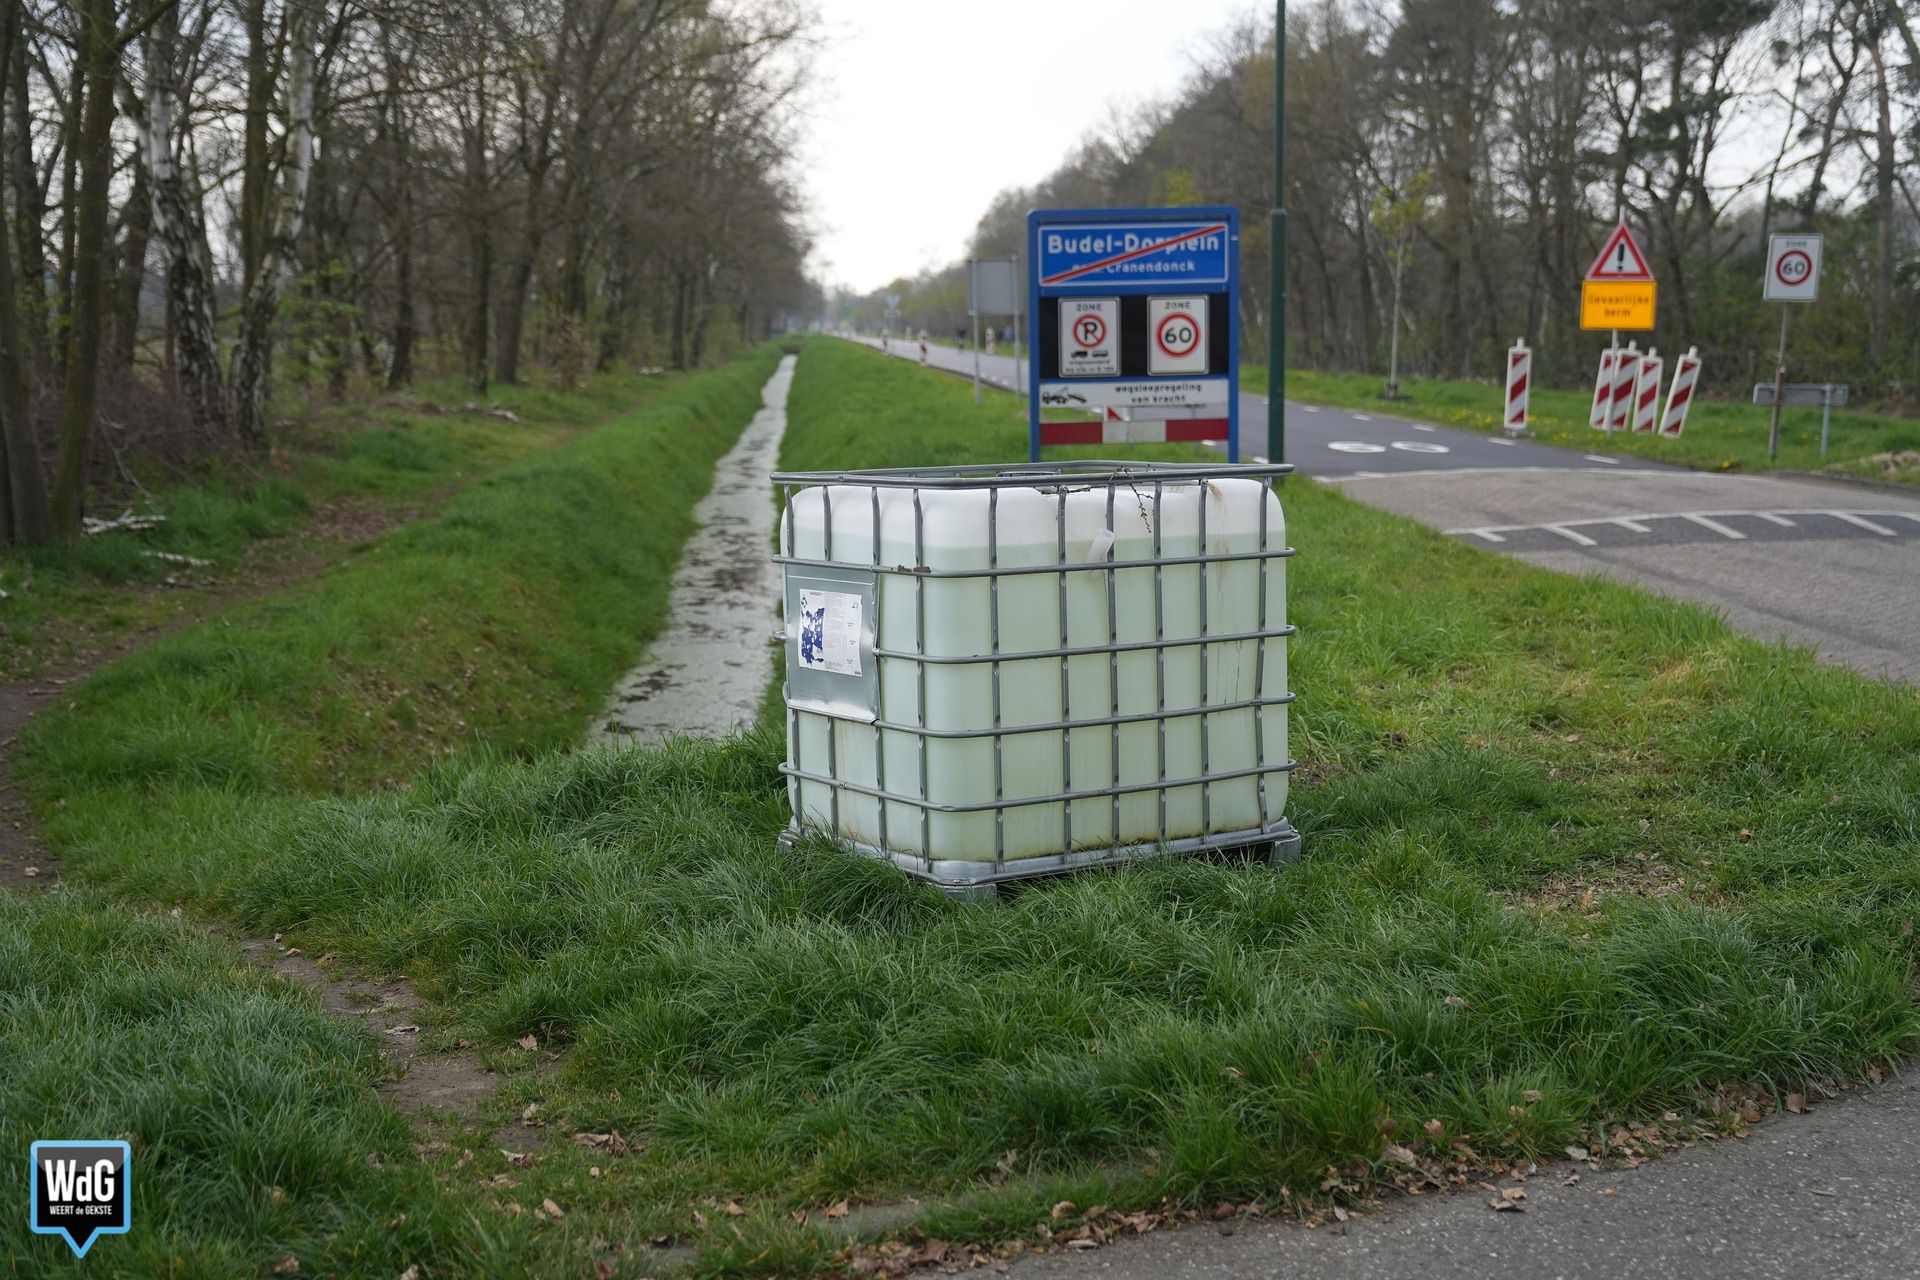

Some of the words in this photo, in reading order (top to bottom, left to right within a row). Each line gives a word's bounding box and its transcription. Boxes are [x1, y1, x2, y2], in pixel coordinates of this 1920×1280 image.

[1106, 260, 1195, 273] Cranendonck
[1783, 261, 1806, 275] 60
[1076, 303, 1103, 312] ZONE
[1165, 301, 1190, 310] ZONE
[1083, 321, 1098, 342] P
[1165, 327, 1192, 344] 60
